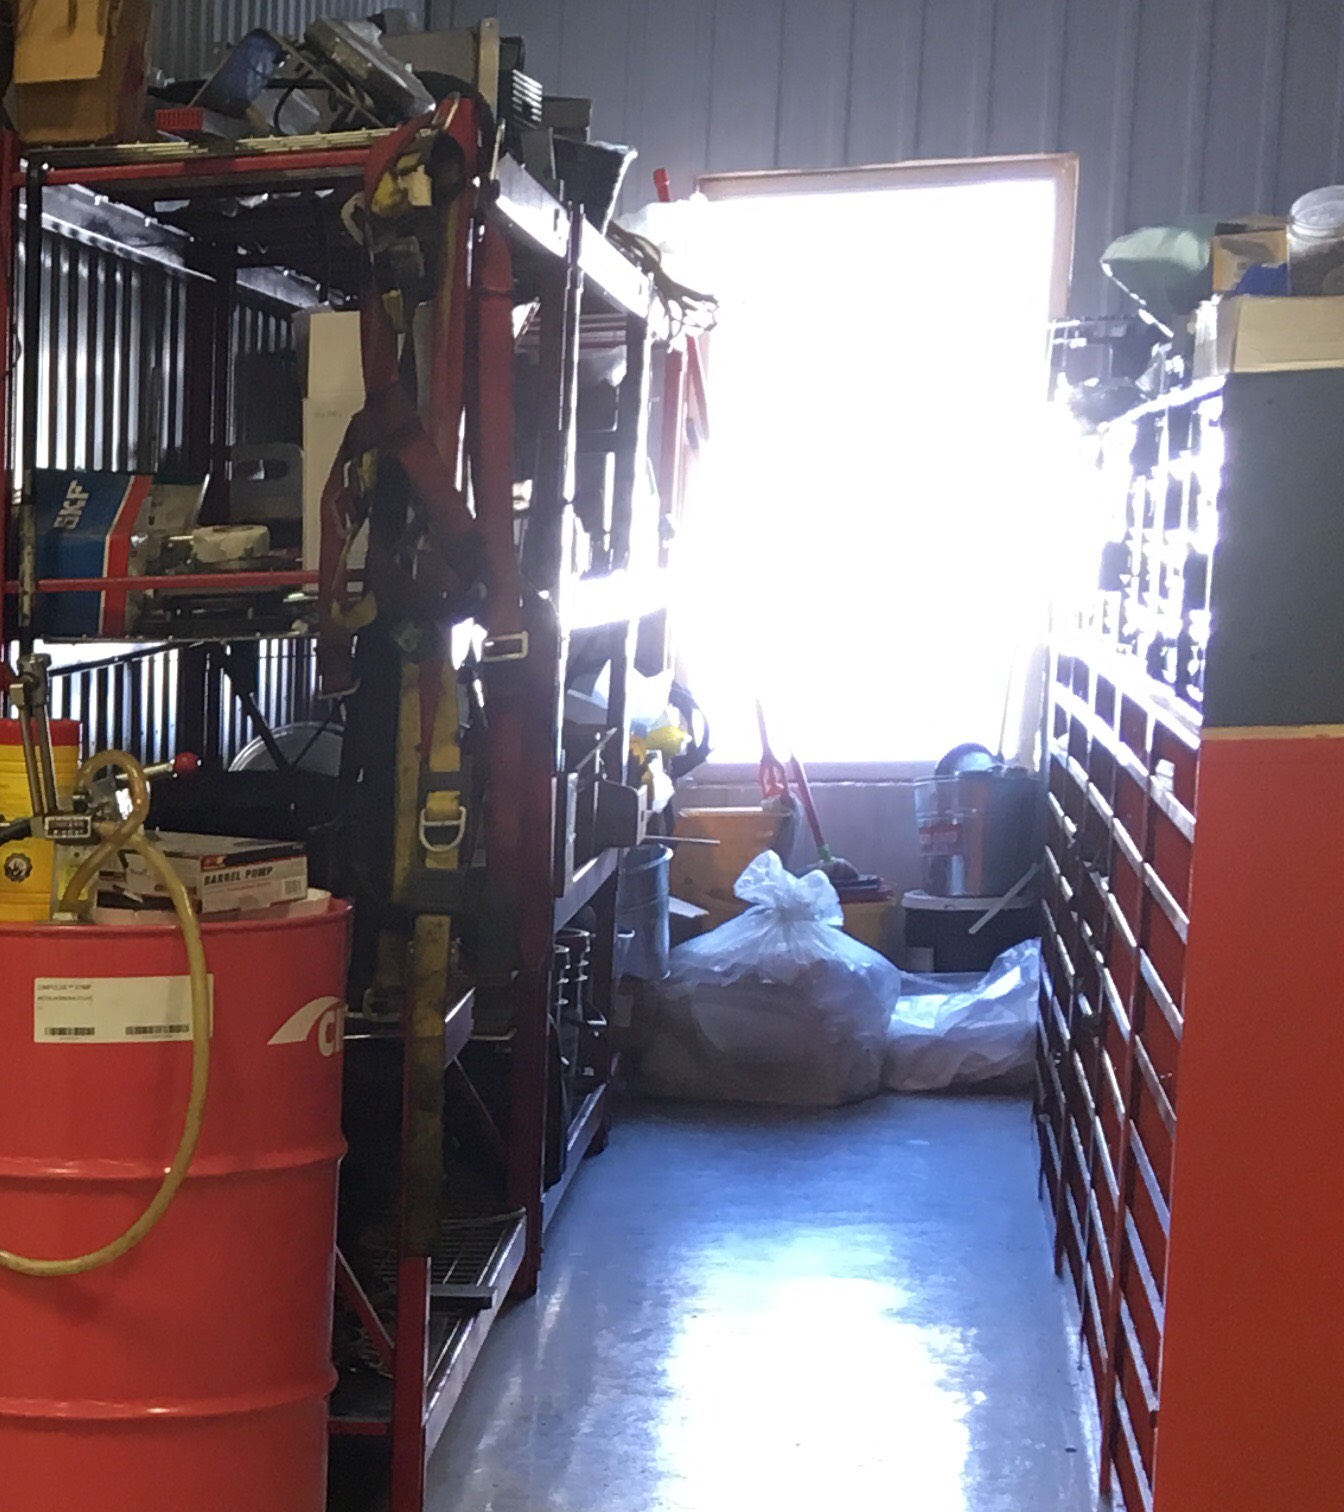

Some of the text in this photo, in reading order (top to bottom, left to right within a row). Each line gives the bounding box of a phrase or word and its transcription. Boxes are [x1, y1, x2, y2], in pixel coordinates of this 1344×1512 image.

[54, 480, 89, 530] SKF
[204, 871, 241, 886] BARREL
[245, 867, 273, 879] PUMP
